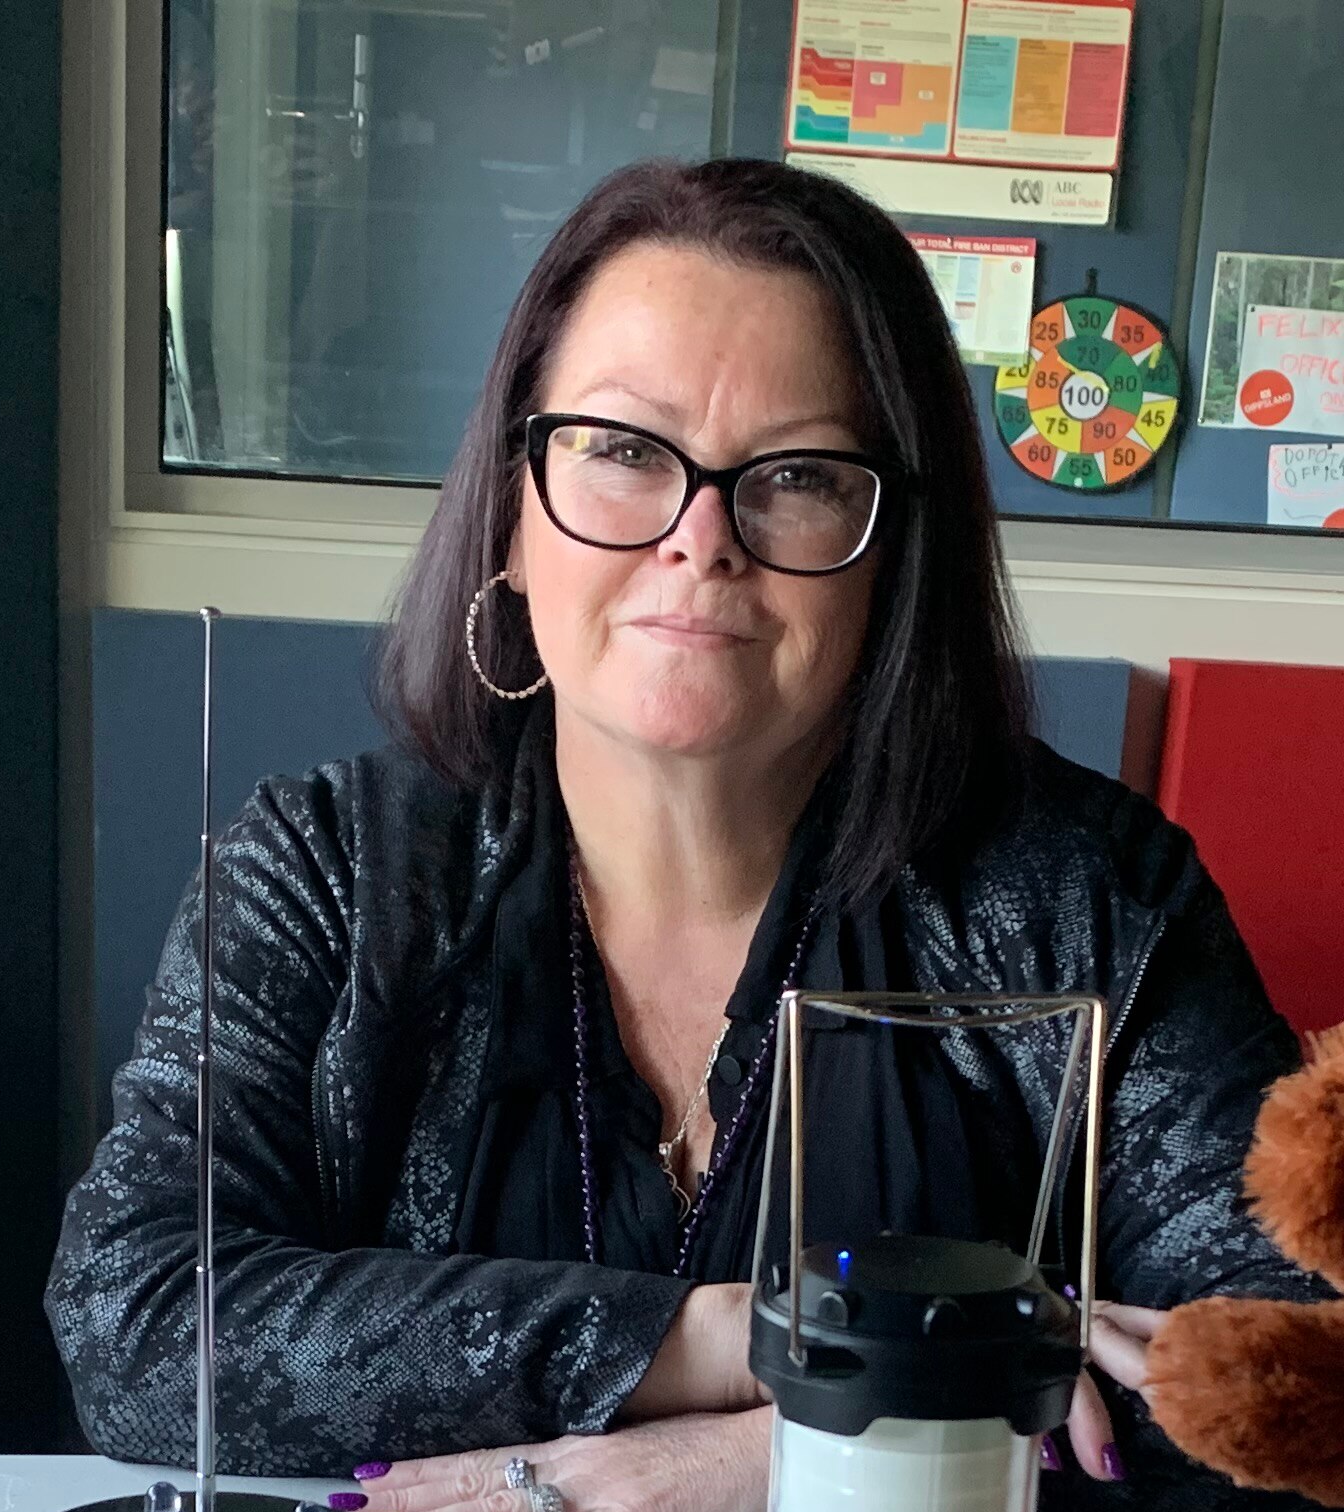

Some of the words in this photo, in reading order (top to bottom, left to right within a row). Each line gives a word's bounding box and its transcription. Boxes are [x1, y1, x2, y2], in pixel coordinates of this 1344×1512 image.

[992, 243, 1029, 254] DISTRICT
[1078, 310, 1101, 329] 30
[1035, 322, 1059, 341] 25
[1120, 325, 1144, 344] 35
[1077, 348, 1100, 366] 70
[1035, 371, 1059, 389] 85
[1114, 375, 1137, 393] 80
[1064, 386, 1104, 406] 100
[1045, 417, 1068, 435] 75
[1141, 410, 1165, 427] 45
[1093, 422, 1116, 439] 90
[1028, 444, 1051, 462] 60
[1113, 448, 1136, 466] 50
[1069, 457, 1092, 475] 55
